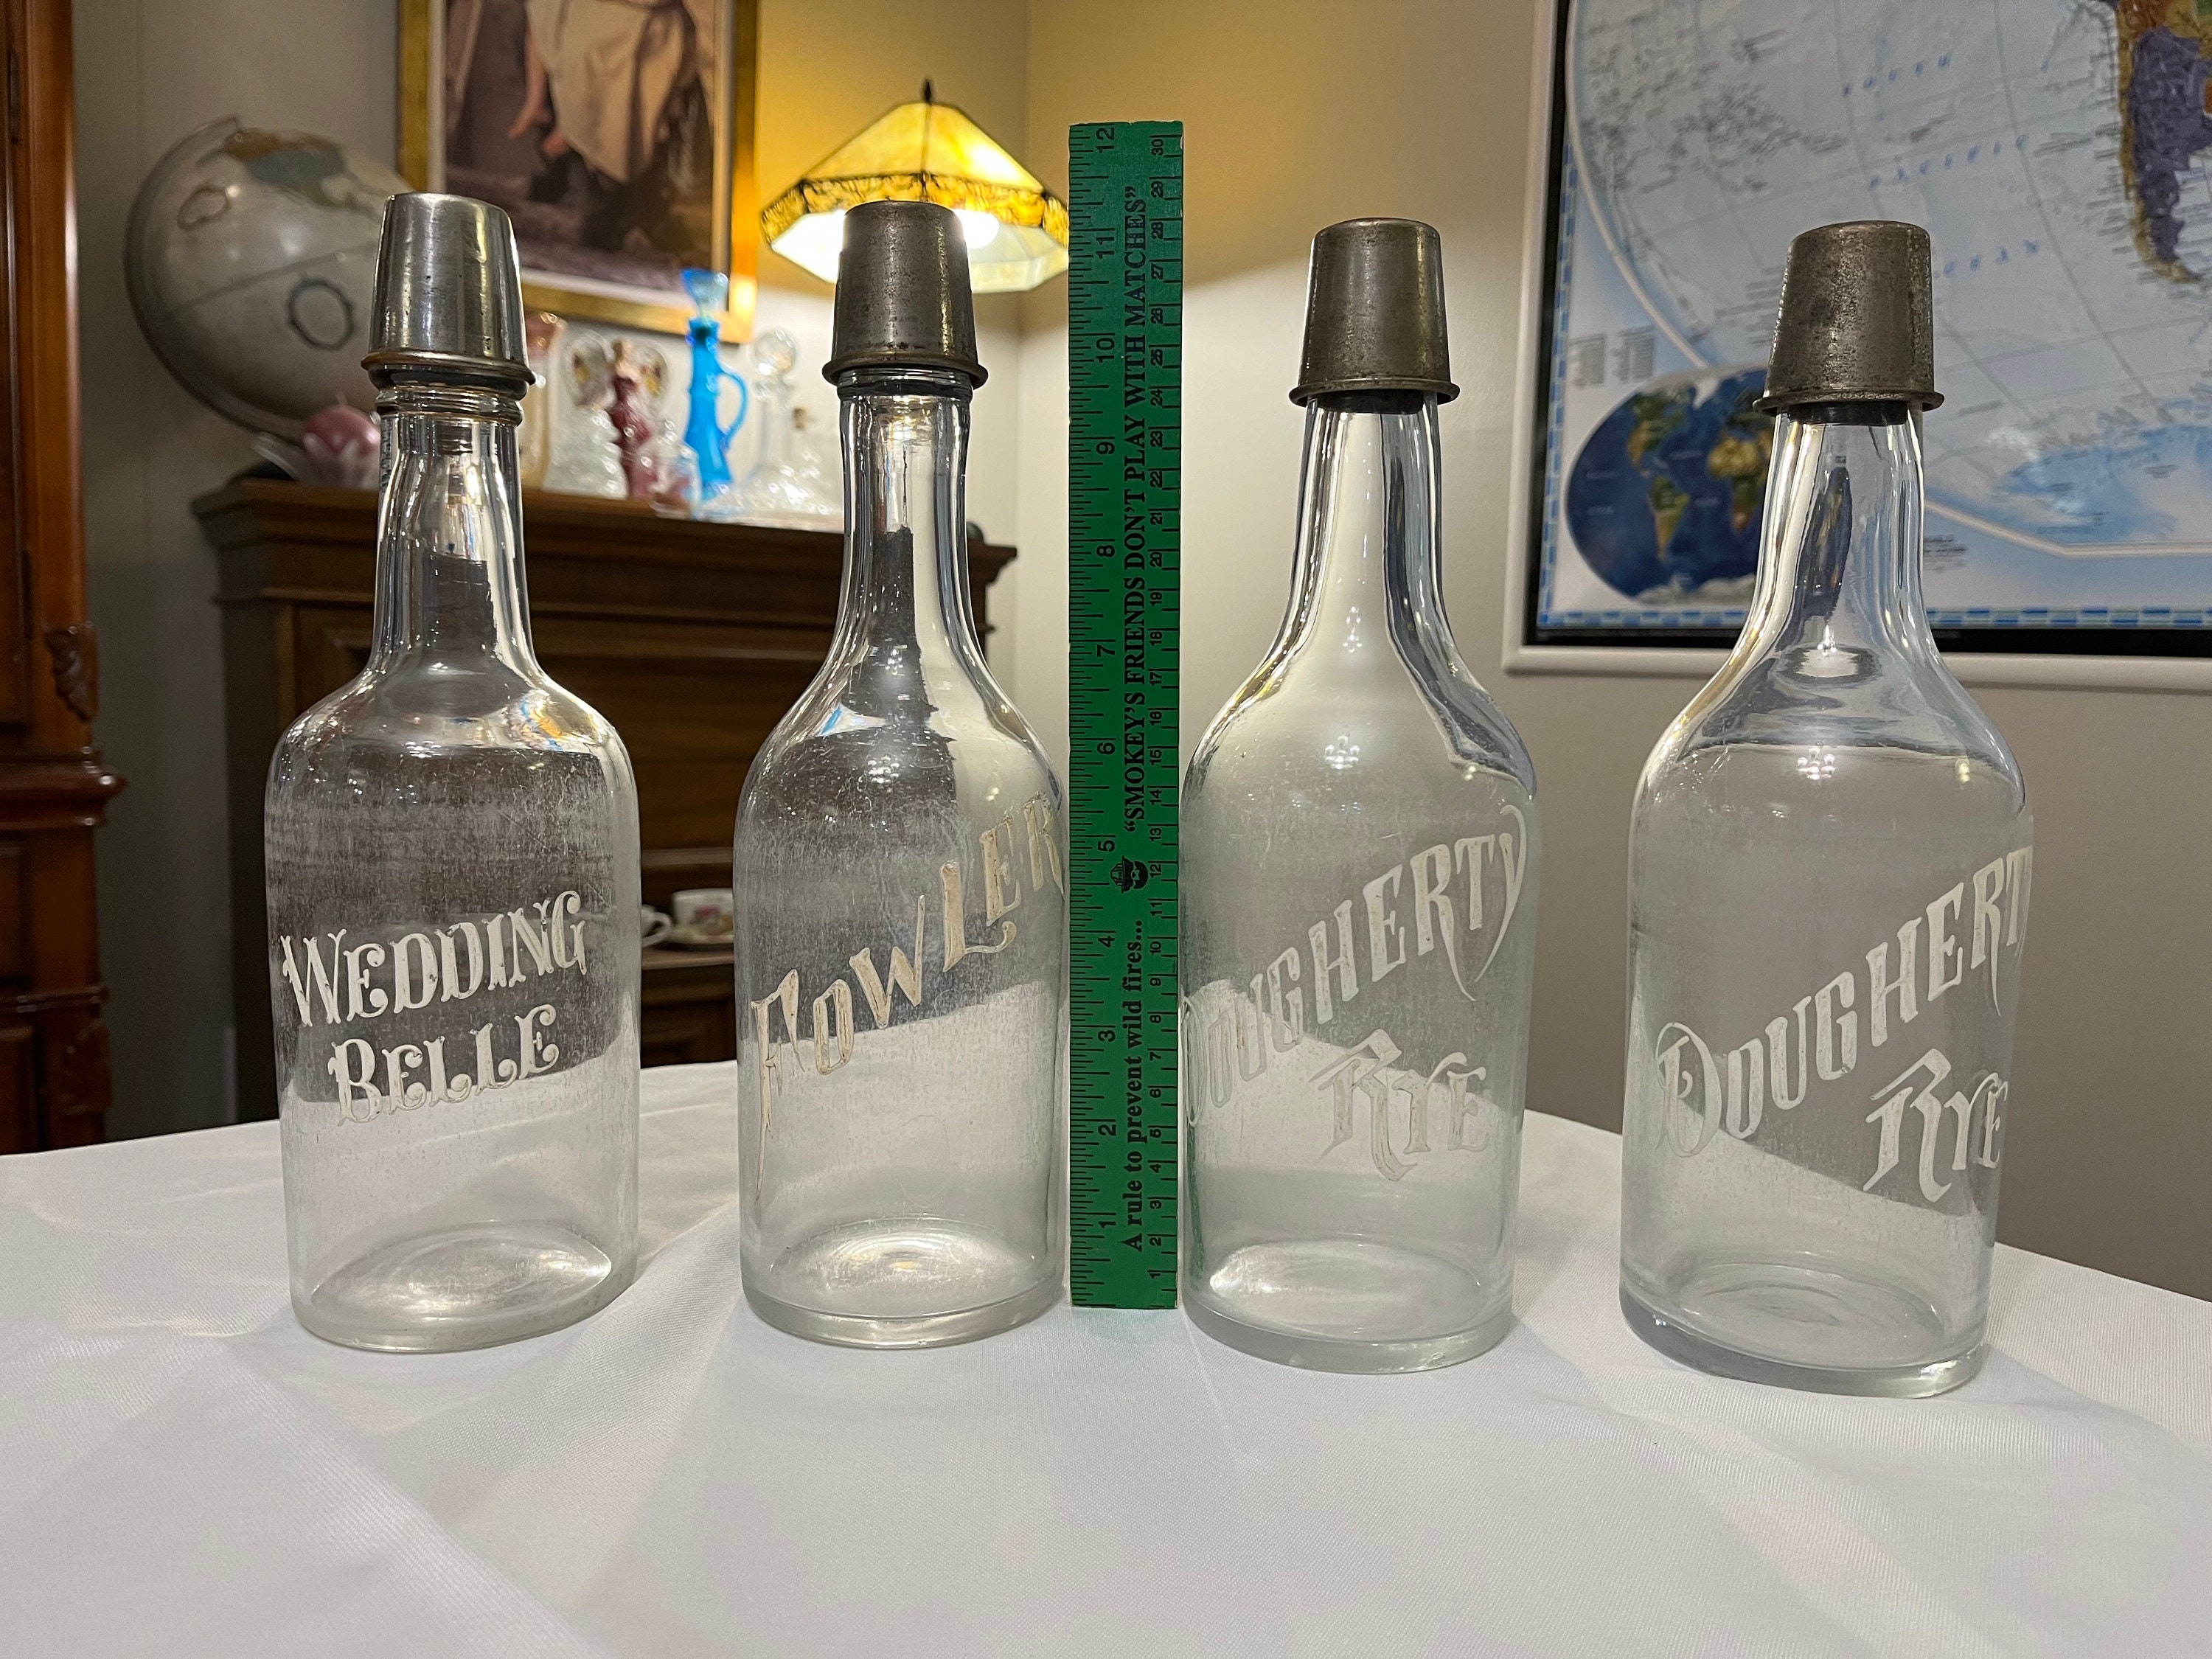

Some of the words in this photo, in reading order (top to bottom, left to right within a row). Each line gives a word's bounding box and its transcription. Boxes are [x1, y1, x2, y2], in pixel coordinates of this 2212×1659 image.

[1095, 127, 1115, 153] 12
[1152, 138, 1164, 156] 30
[1151, 181, 1164, 198] 29
[1151, 222, 1164, 240] 28
[1095, 236, 1115, 260] 11
[1151, 263, 1164, 280] 27
[1151, 307, 1164, 324] 26
[1095, 337, 1115, 363] 10
[1151, 349, 1164, 366] 25
[1124, 335, 1146, 408] WITH
[1151, 389, 1164, 406] 24
[1150, 430, 1163, 448] 23
[1096, 442, 1116, 455] 9
[1123, 414, 1146, 481] PLAY
[1150, 470, 1163, 488] 22
[1150, 511, 1163, 526] 21
[1123, 489, 1146, 571] DON’T
[1096, 544, 1116, 557] 8
[1150, 552, 1163, 568] 20
[1150, 591, 1162, 607] 19
[1123, 577, 1146, 686] FRIENDS
[1150, 631, 1162, 647] 18
[1096, 644, 1116, 658] 7
[1150, 671, 1162, 686] 17
[1150, 710, 1162, 726] 16
[1097, 742, 1116, 755] 6
[1150, 749, 1162, 766] 15
[1150, 789, 1162, 806] 14
[1150, 827, 1162, 842] 13
[1097, 840, 1116, 852] 5
[1150, 863, 1162, 879] 12
[1150, 902, 1162, 917] 11
[1097, 935, 1116, 948] 4
[1150, 941, 1162, 956] 10
[280, 890, 588, 1027] WEDDING
[1122, 919, 1143, 992] fires...
[1150, 977, 1162, 987] 9
[750, 790, 1065, 1202] FOWLER
[1121, 1001, 1143, 1049] wild
[1150, 1014, 1162, 1023] 8
[1097, 1029, 1116, 1043] 3
[1150, 1051, 1162, 1062] 7
[327, 1004, 560, 1126] BELLE
[1123, 1055, 1147, 1144] prevent
[1150, 1088, 1162, 1099] 6
[1097, 1124, 1116, 1136] 2
[1150, 1127, 1162, 1138] 5
[1123, 1151, 1143, 1173] to
[1150, 1164, 1162, 1174] 4
[1121, 1180, 1143, 1225] rule
[1150, 1200, 1162, 1209] 3
[1098, 1221, 1116, 1229] 1
[1121, 1233, 1143, 1253] A
[1150, 1237, 1162, 1247] 2
